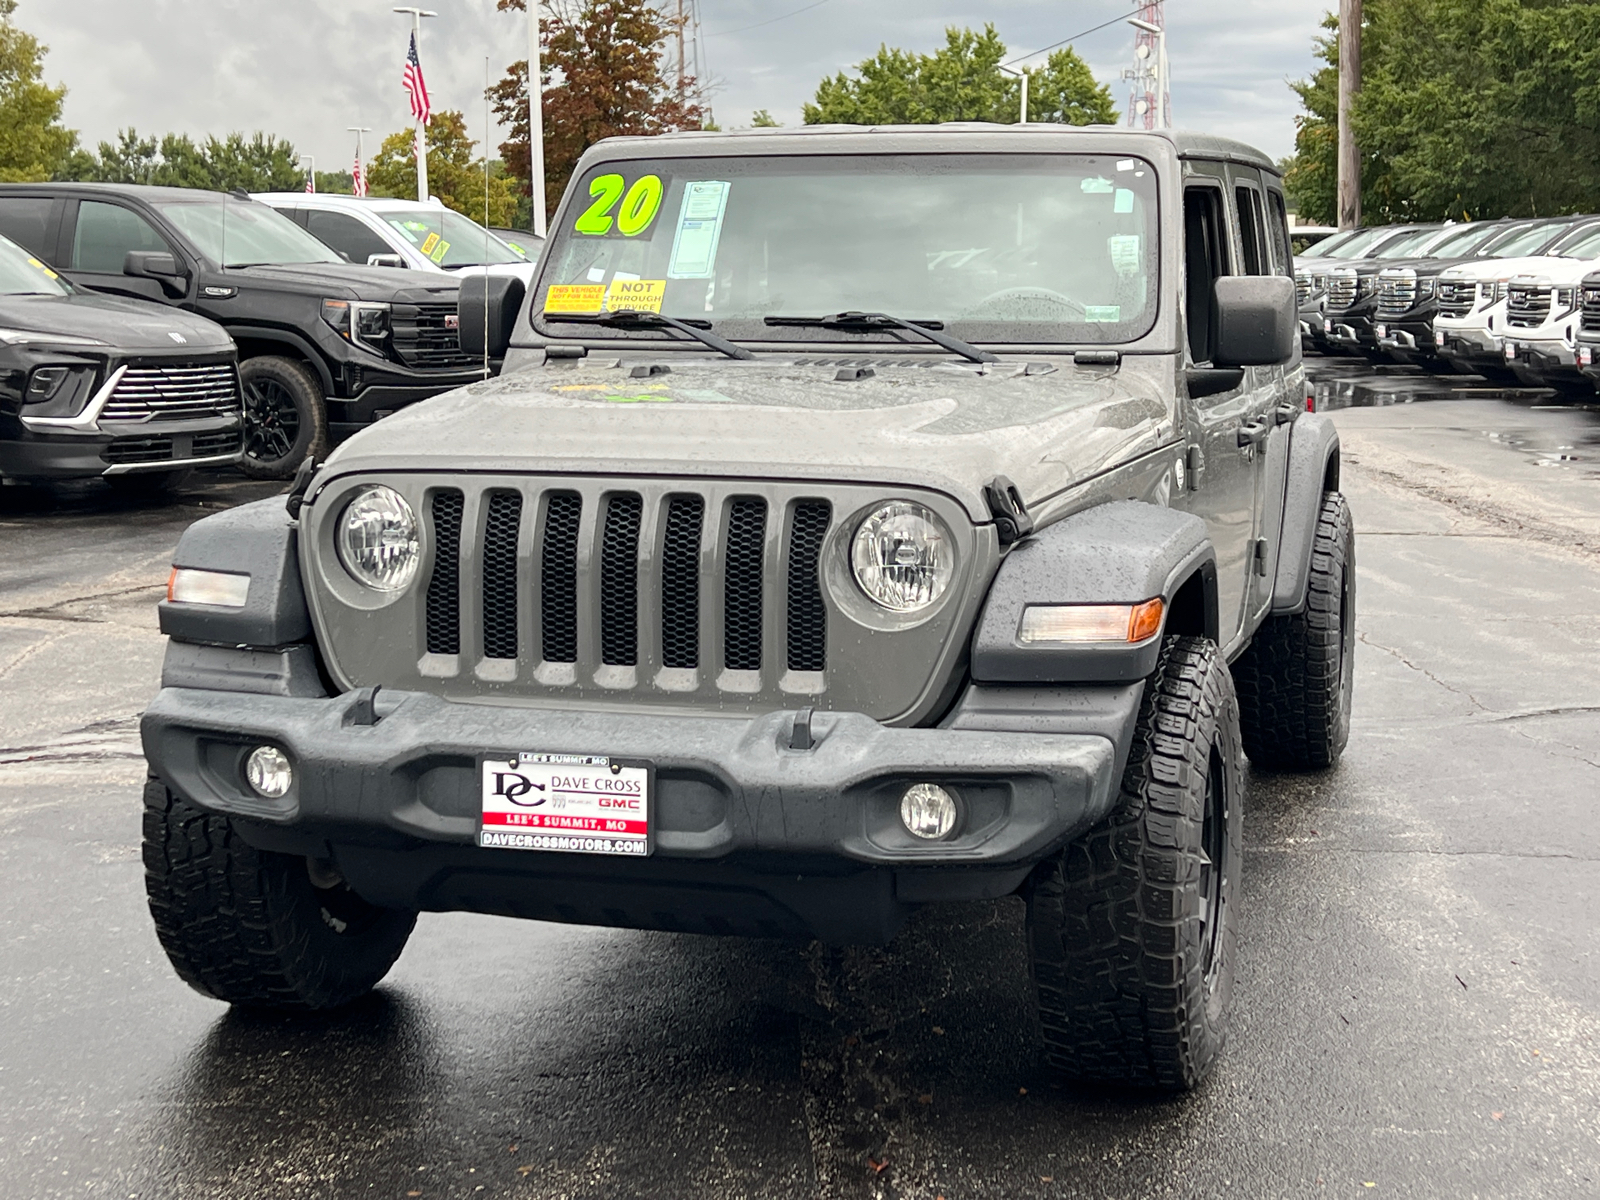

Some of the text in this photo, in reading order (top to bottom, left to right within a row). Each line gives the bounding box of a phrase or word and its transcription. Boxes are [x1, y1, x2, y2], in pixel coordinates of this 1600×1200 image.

[574, 173, 664, 237] 20
[620, 282, 655, 293] NOT
[610, 303, 656, 311] SERVICE
[548, 754, 587, 764] SUMMIT
[551, 775, 641, 793] DAVE CROSS
[598, 798, 640, 809] GMC
[506, 814, 627, 831] LEE'S SUMMIT, MO
[483, 834, 644, 854] DAVECROSSMOTORS.COM
